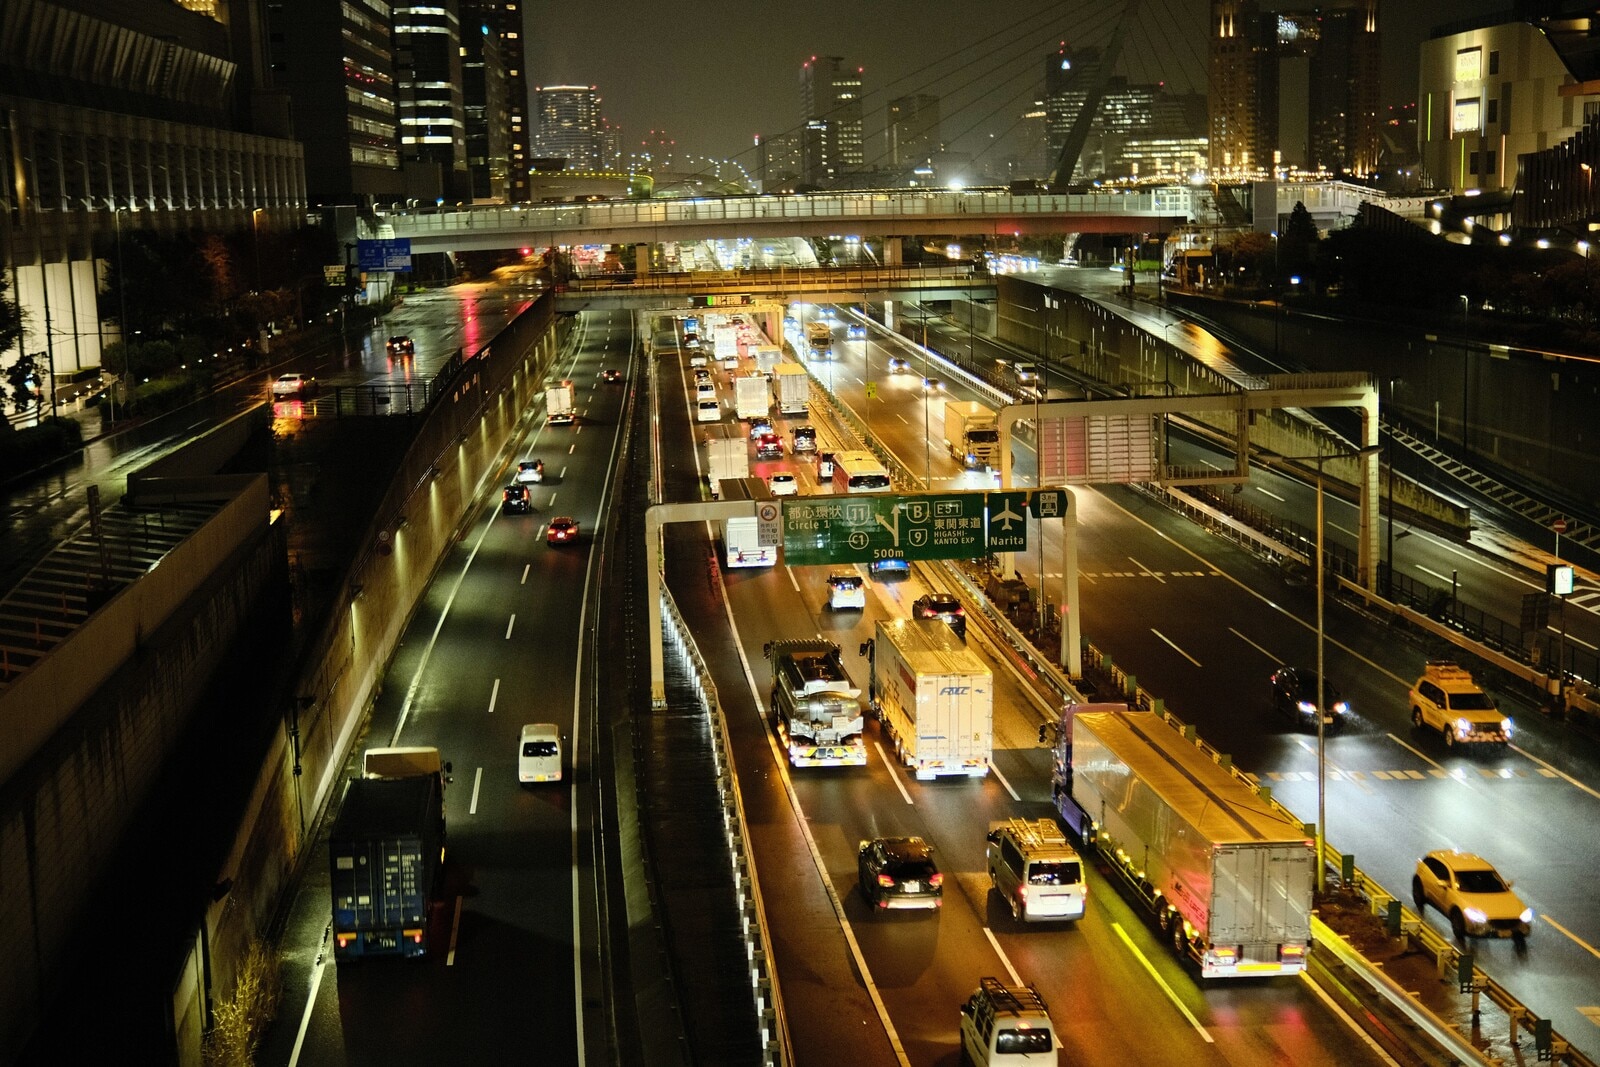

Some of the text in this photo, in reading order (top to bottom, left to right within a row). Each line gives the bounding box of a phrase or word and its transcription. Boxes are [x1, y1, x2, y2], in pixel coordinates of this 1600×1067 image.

[788, 505, 842, 520] 都心環状
[851, 507, 865, 521] 11
[913, 505, 922, 519] B
[936, 503, 959, 515] E51
[788, 519, 830, 530] Circle 1
[934, 517, 981, 530] 東関東道
[914, 531, 922, 542] 9
[934, 530, 968, 538] HIGASHI-
[852, 534, 864, 546] C1
[934, 537, 958, 545] KANTO
[990, 536, 1024, 546] Narita
[873, 549, 904, 558] 500m
